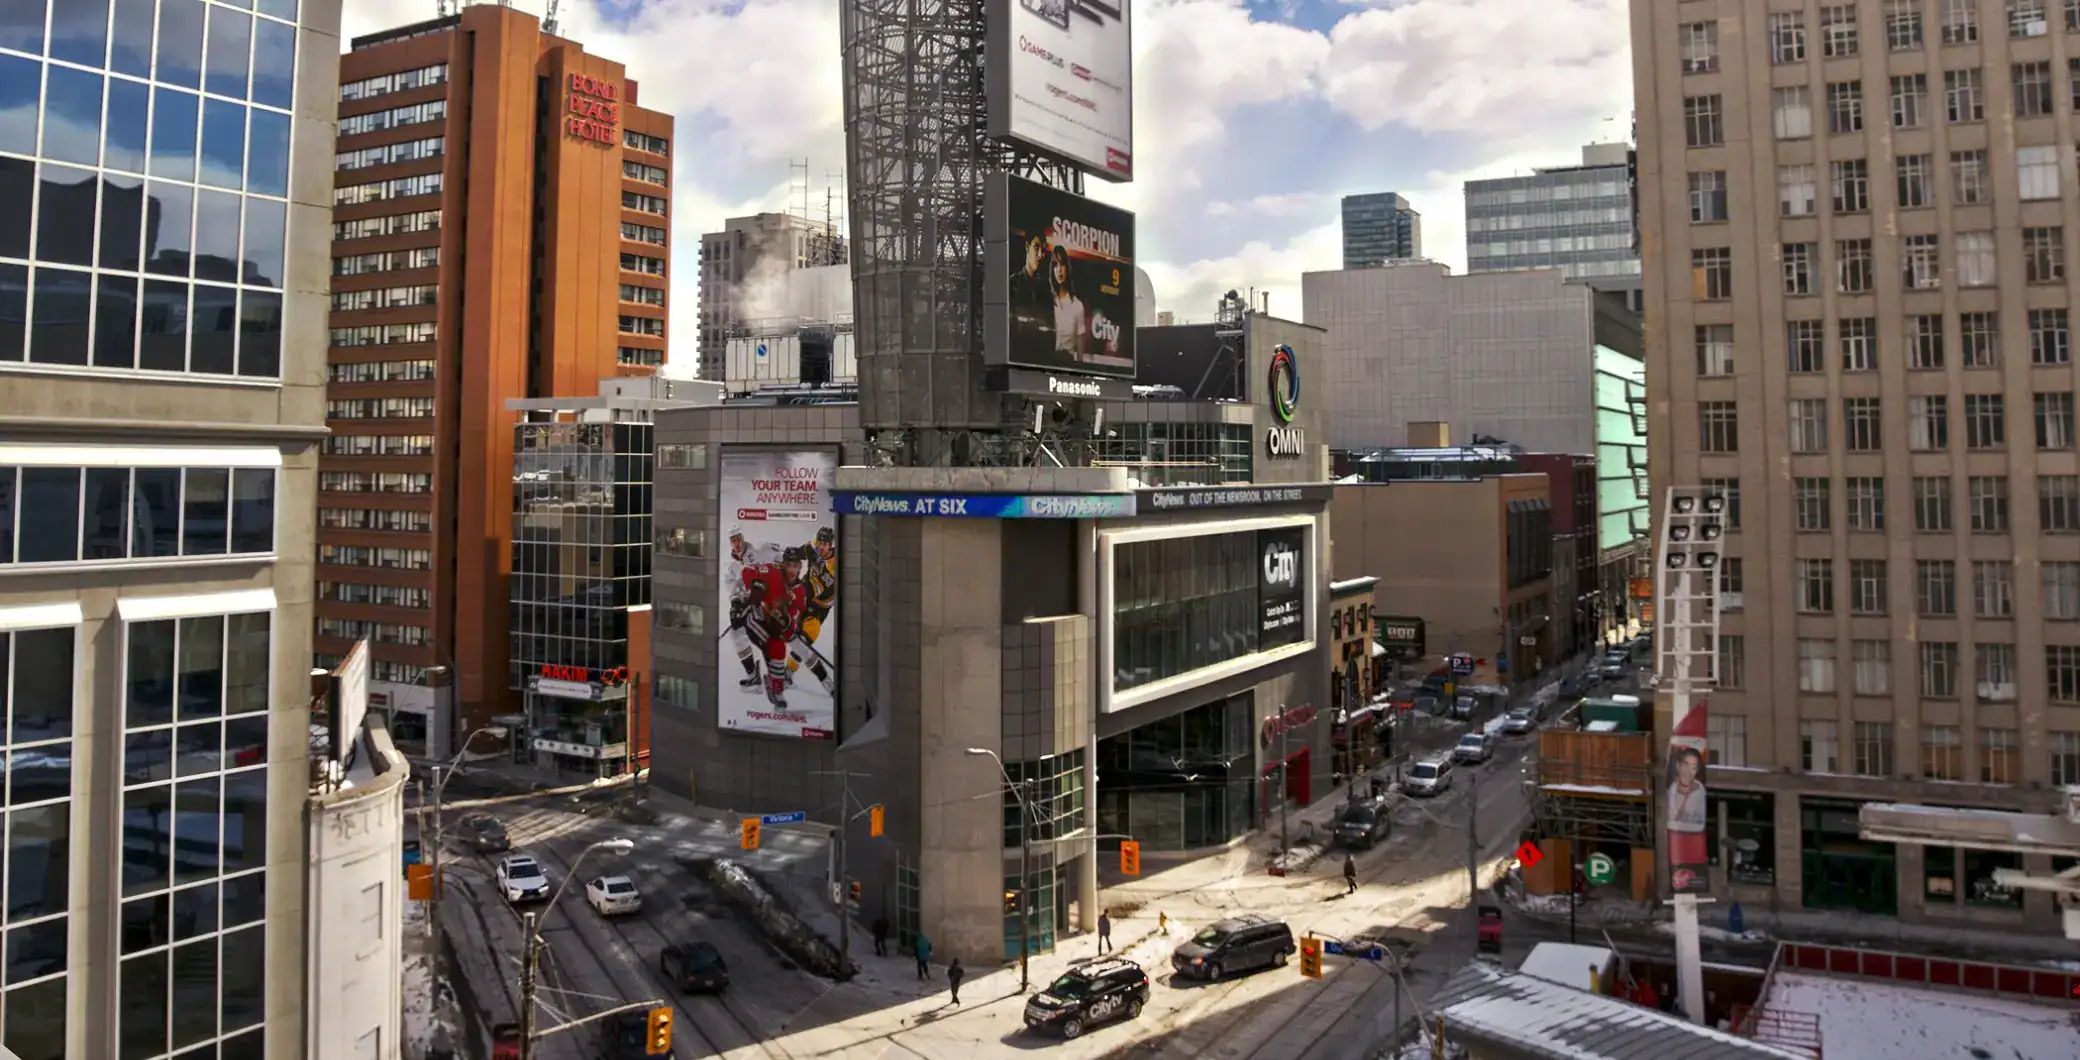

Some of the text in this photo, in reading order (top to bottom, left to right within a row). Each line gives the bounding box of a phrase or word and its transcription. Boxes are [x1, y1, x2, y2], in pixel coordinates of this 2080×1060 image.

[571, 72, 619, 99] BOND
[570, 95, 619, 122] PLACE
[570, 117, 616, 145] HOTEL
[1053, 216, 1119, 257] SCORPION
[1112, 268, 1120, 286] 9
[1092, 313, 1120, 352] City
[1049, 377, 1101, 396] Panasonic
[1269, 426, 1304, 455] OMNI
[775, 467, 818, 479] FOLLOW
[752, 480, 819, 492] YOUR TEAM.
[756, 492, 819, 505] ANYWHERE.
[915, 498, 935, 514] AT
[939, 498, 967, 515] SIX
[1189, 491, 1203, 506] OUT
[1204, 491, 1213, 504] OF
[1214, 491, 1226, 504] THE
[1263, 489, 1272, 502] ON
[1272, 489, 1282, 501] THE
[1264, 541, 1299, 588] City
[541, 664, 588, 682] HAKIM
[1591, 860, 1610, 877] P
[1090, 994, 1123, 1018] Citytv
